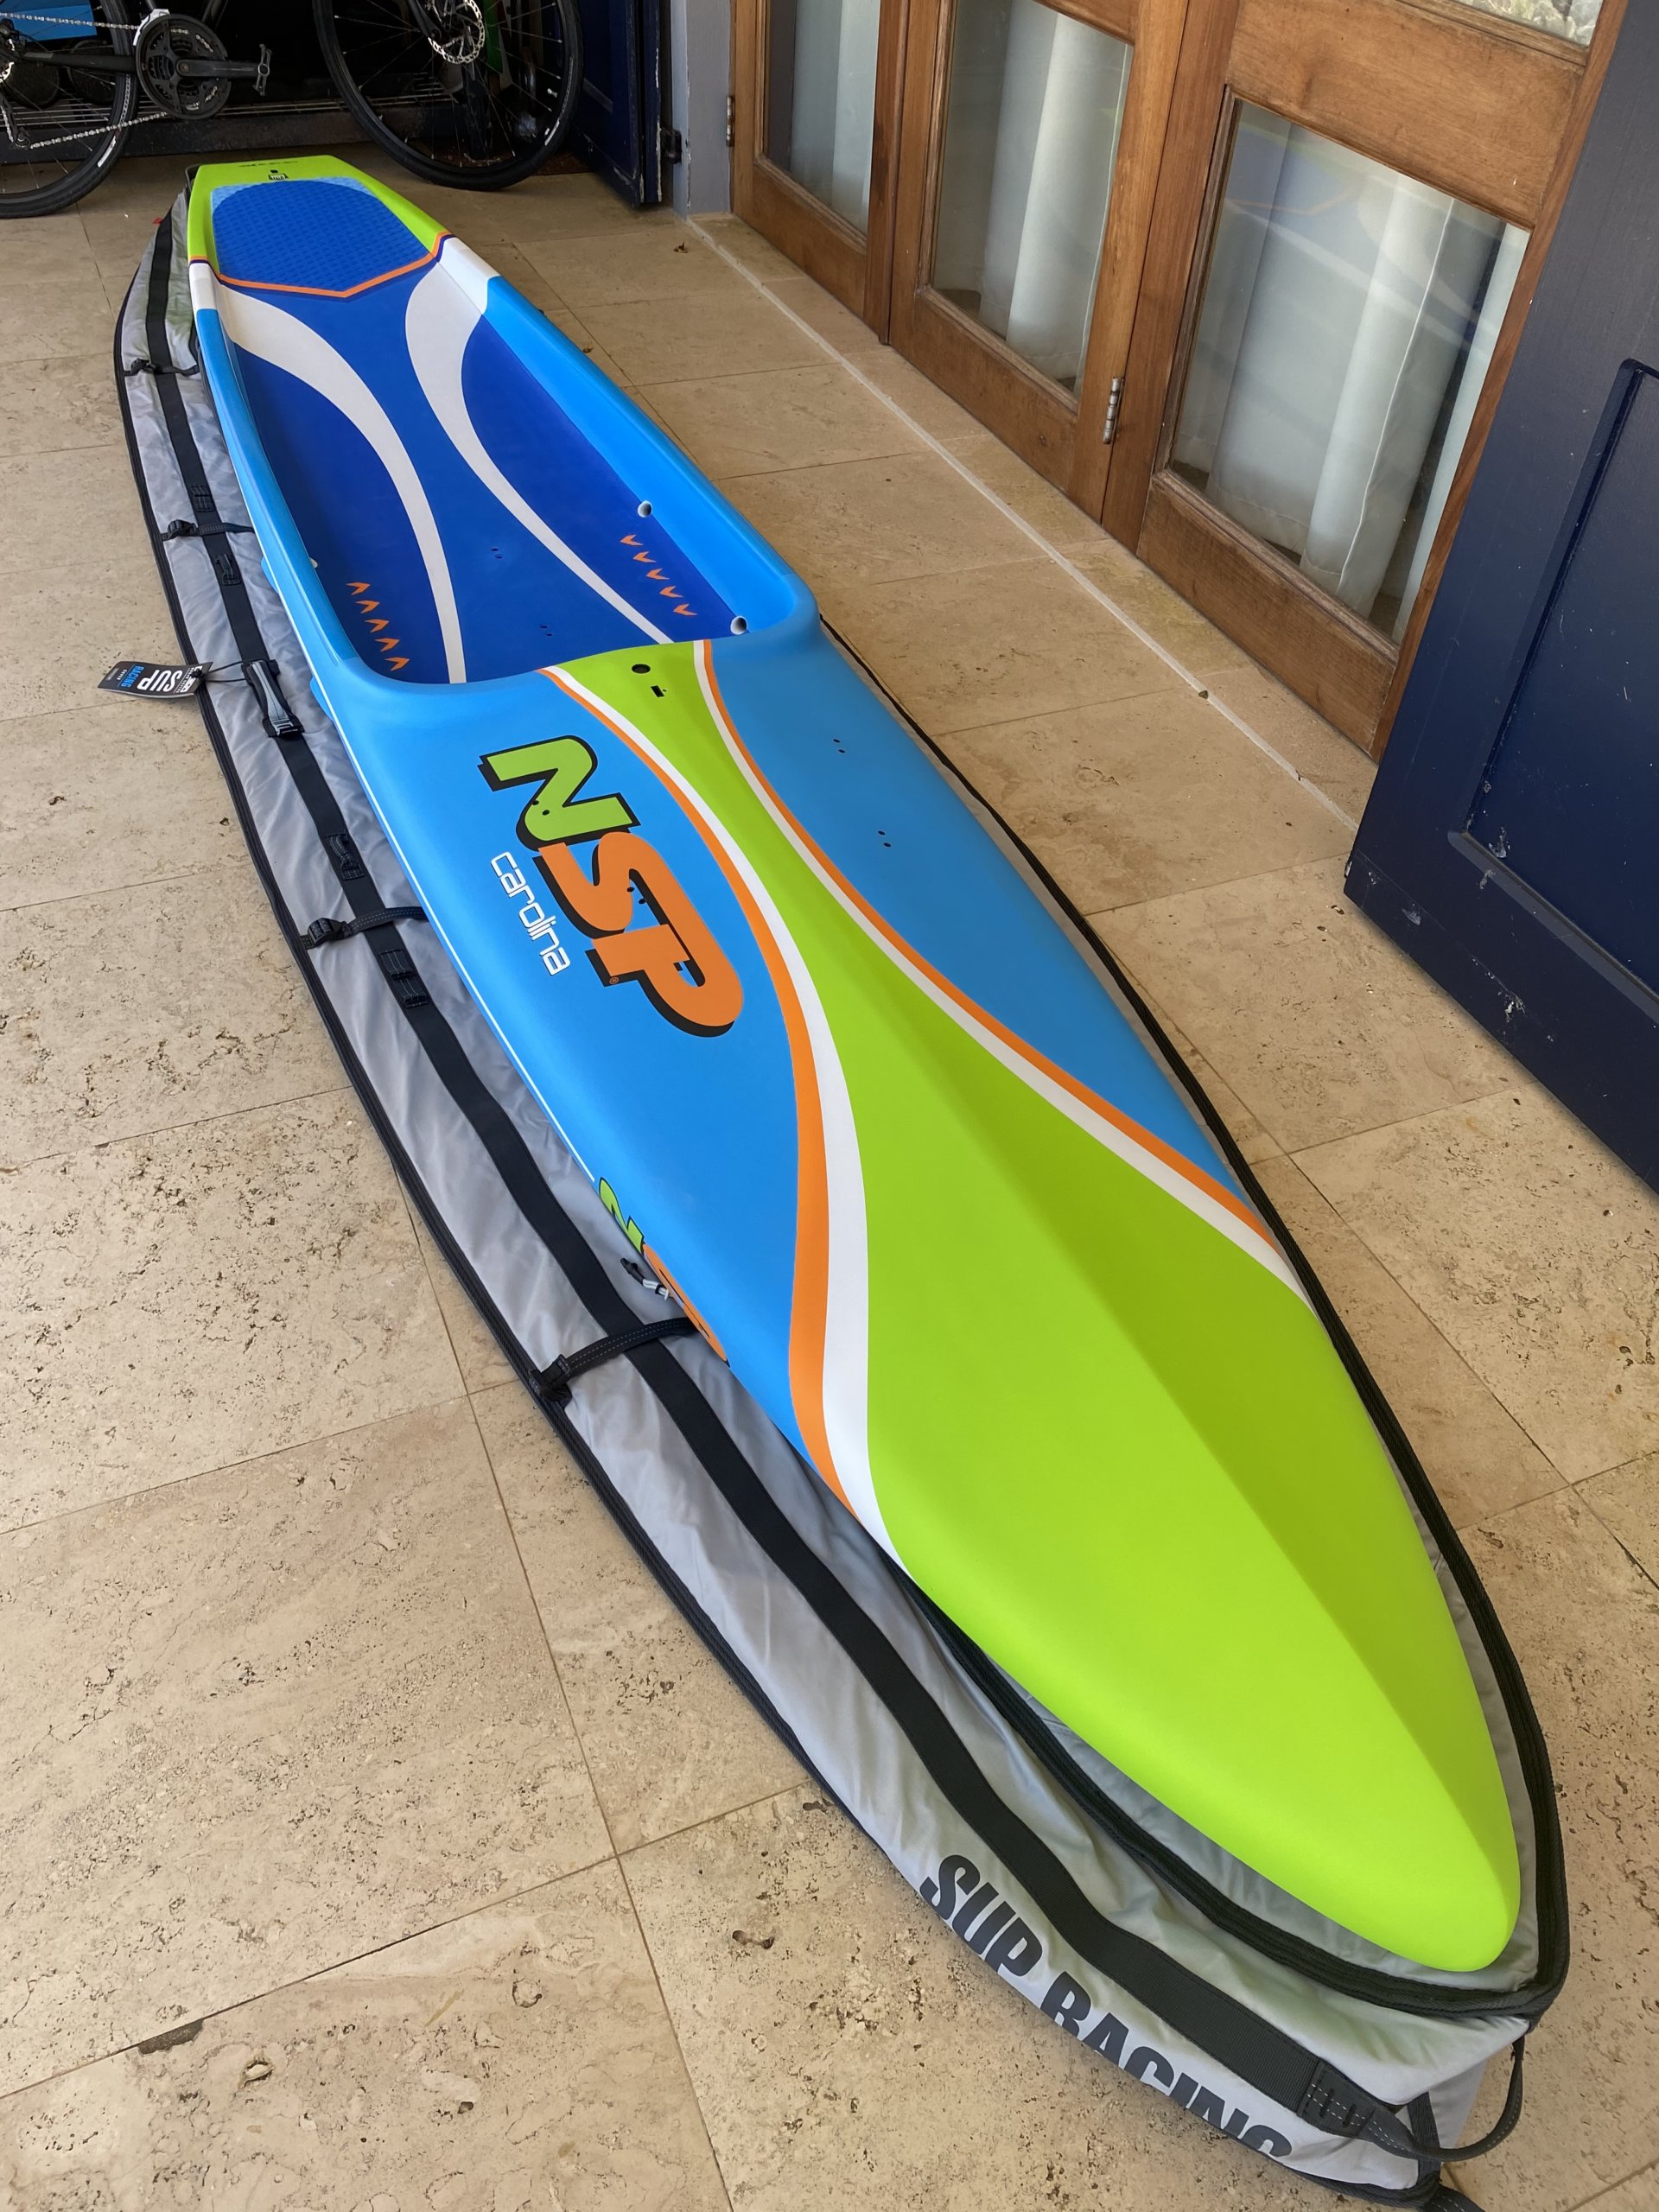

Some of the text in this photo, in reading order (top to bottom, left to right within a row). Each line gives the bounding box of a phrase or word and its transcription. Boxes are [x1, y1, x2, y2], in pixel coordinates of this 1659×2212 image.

[121, 665, 144, 688] RACING
[137, 670, 182, 692] SUP
[477, 735, 744, 1037] NSP
[491, 852, 571, 976] carolina
[919, 1854, 1043, 1976] SUP
